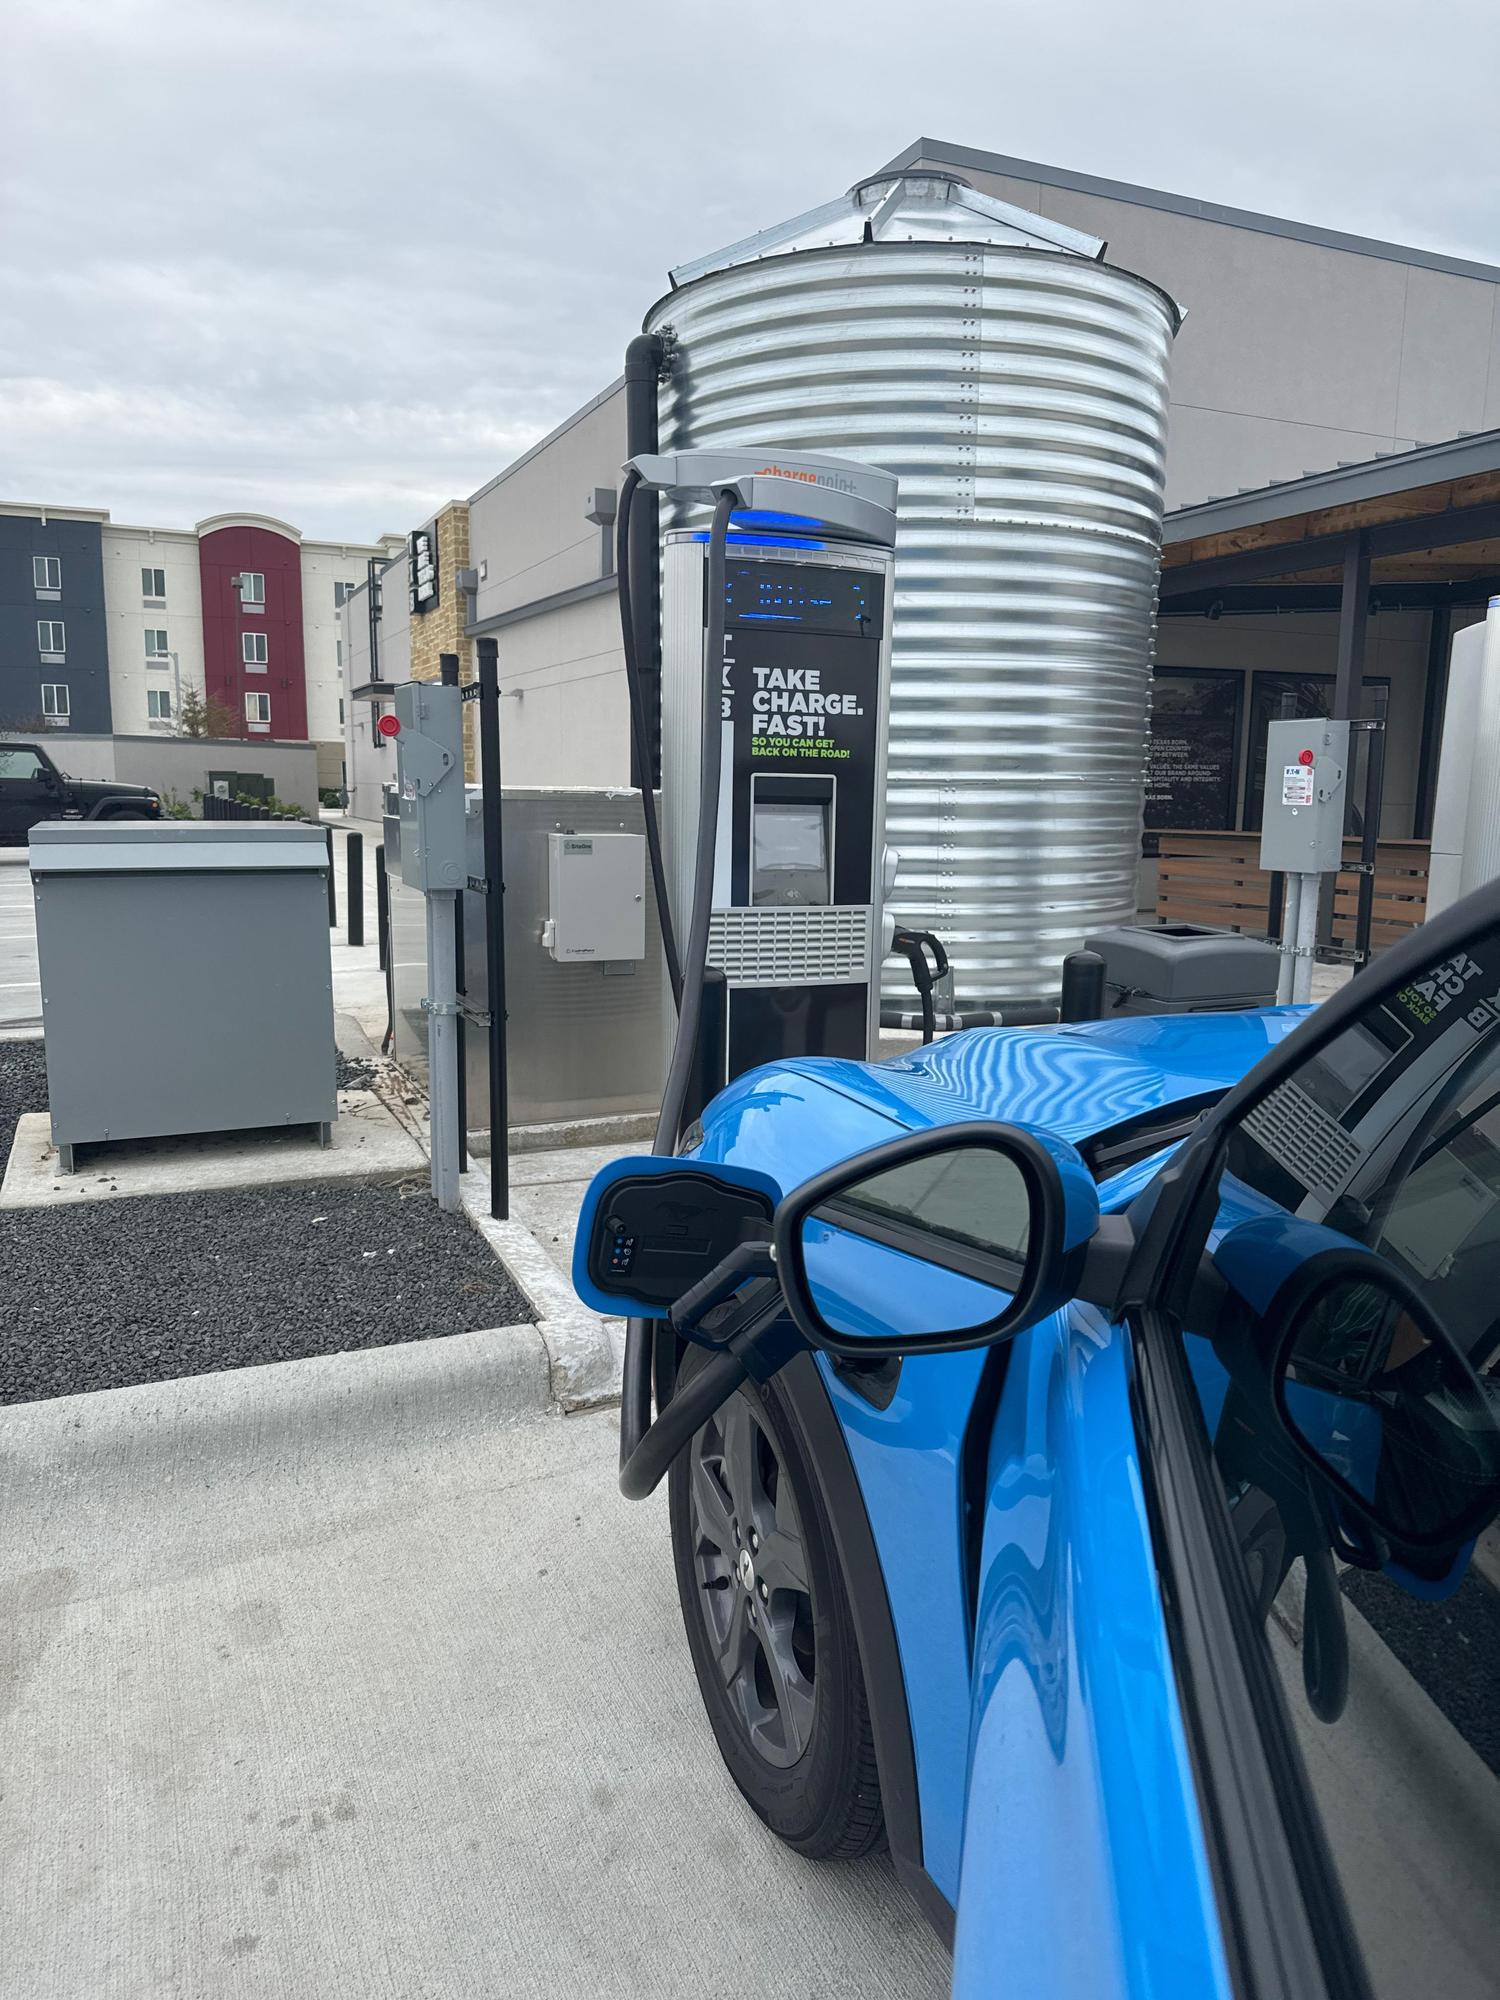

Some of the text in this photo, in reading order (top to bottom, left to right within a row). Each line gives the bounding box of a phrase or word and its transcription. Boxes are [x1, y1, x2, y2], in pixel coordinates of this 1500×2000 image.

[752, 667, 820, 691] TAKE
[752, 691, 864, 716] CHARGE.
[752, 714, 826, 737] FAST!
[752, 737, 834, 749] SO YOU CAN GET
[752, 747, 850, 758] BACK ON THE ROAD!
